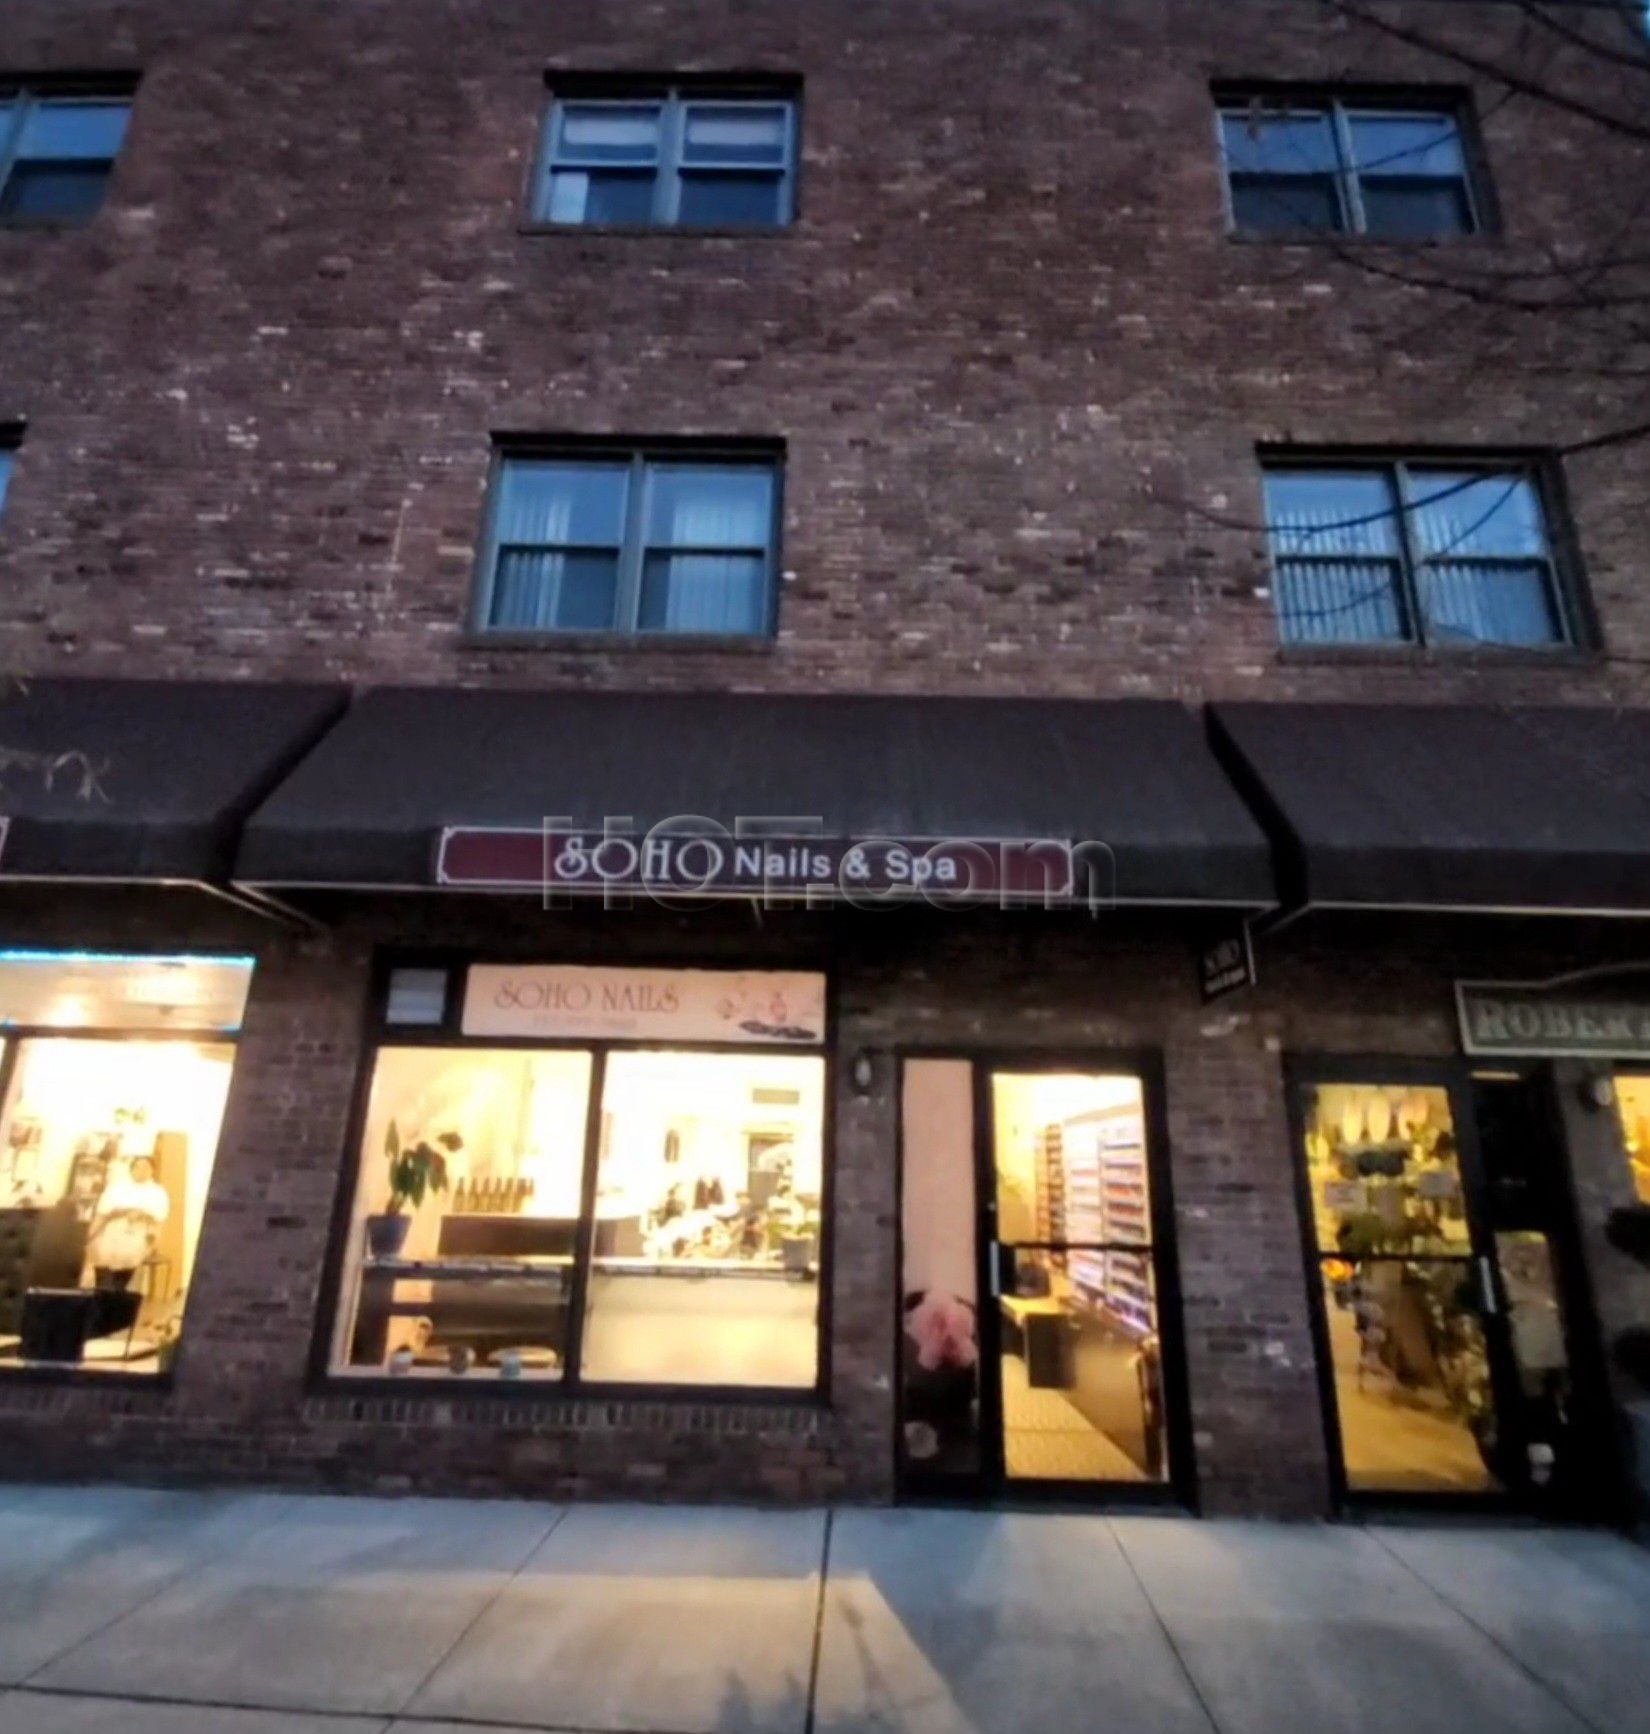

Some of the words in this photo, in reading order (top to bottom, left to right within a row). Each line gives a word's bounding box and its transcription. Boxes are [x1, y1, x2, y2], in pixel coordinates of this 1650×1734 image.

[553, 836, 723, 880] SOHO
[734, 846, 831, 878] Nails
[844, 847, 871, 879] &
[884, 848, 957, 892] Spa
[493, 979, 592, 1011] SOHO
[601, 982, 680, 1014] NAILS
